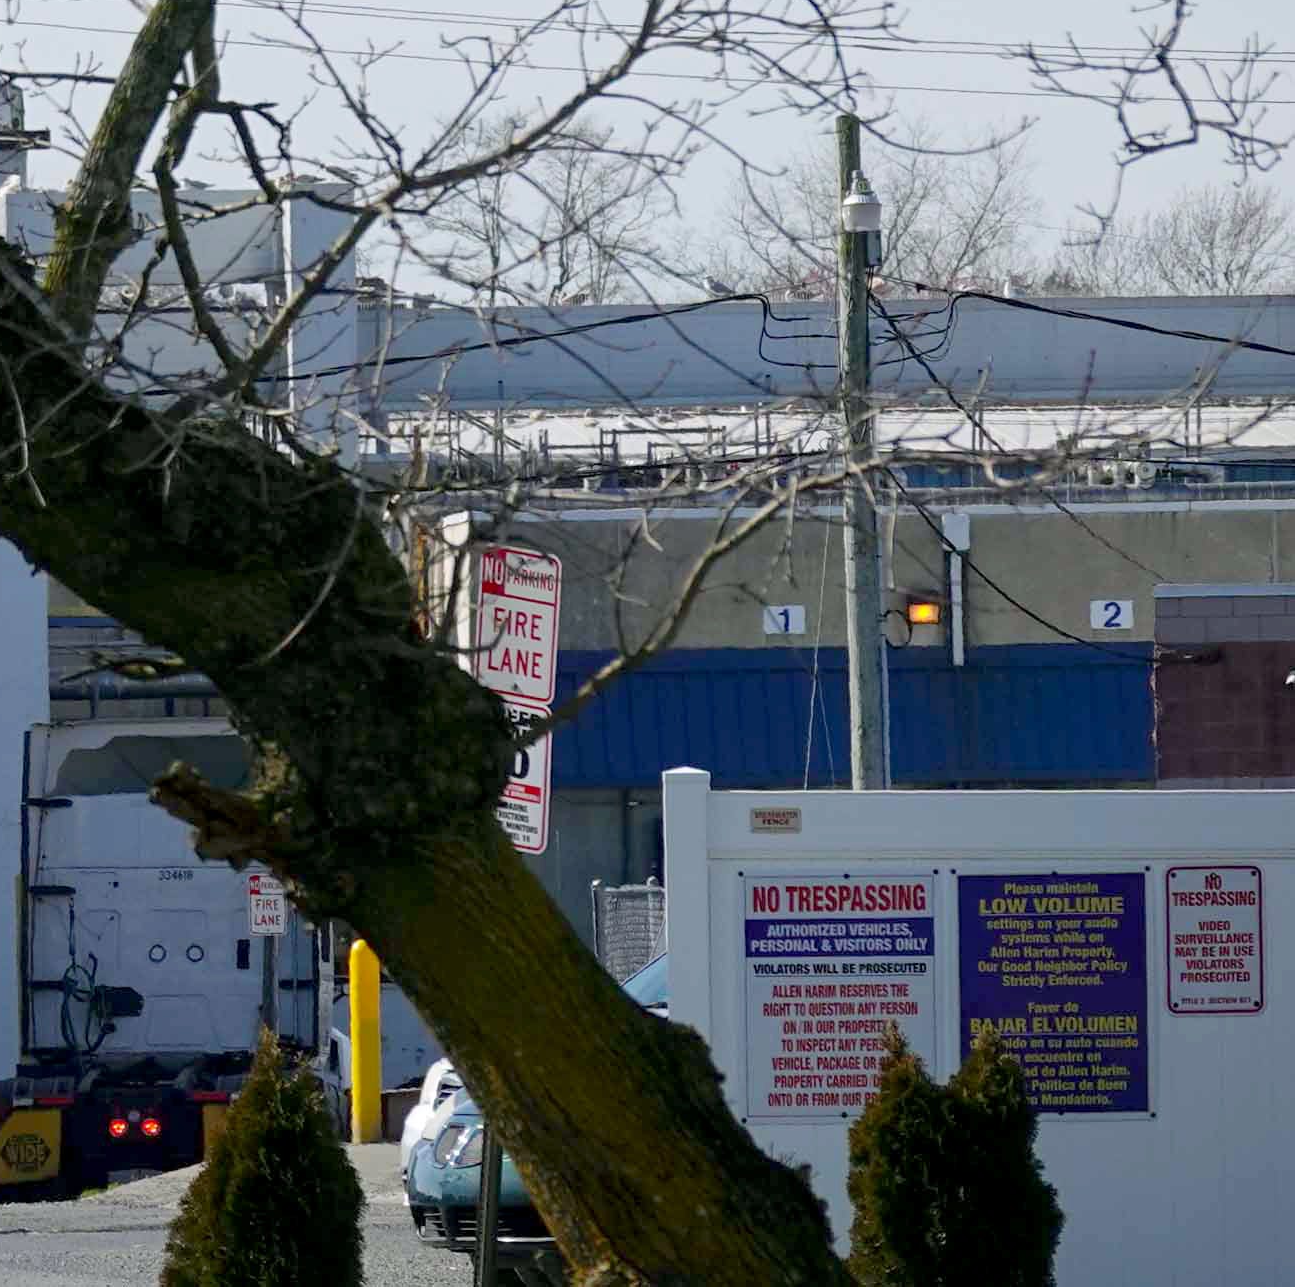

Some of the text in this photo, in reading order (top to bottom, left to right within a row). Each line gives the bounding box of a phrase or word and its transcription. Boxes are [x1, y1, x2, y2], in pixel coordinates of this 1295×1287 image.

[483, 555, 554, 591] NO PARKING
[778, 609, 789, 632] 1
[1104, 602, 1121, 627] 2
[494, 607, 542, 641] FIRE
[488, 648, 543, 679] LANE
[1004, 882, 1099, 894] Please maintain
[1205, 875, 1222, 890] NO
[255, 899, 279, 910] FIRE
[753, 884, 926, 912] NO TRESPASSING
[1172, 891, 1256, 906] TRESPASSING
[979, 897, 1125, 914] LOW VOLUME
[254, 915, 281, 926] LANE
[986, 917, 1118, 931] settings on your audio
[1198, 921, 1231, 931] VIDEO
[767, 923, 913, 938] AUTHORIZED VEHICLES,
[751, 937, 928, 952] PERSONAL & VISITORS ONLY
[1001, 932, 1104, 945] systems while on
[1175, 933, 1254, 945] SURVEILLANCE
[991, 947, 1021, 958] Allen
[1024, 947, 1059, 958] Harim
[1175, 946, 1254, 957] MAY BE IN USE
[753, 963, 927, 974] VIOLATORS WILL BE PROSECUTED
[978, 960, 1127, 974] Our Good Neighbor Policy
[1186, 959, 1244, 970] VIOLATORS
[1002, 975, 1045, 988] Strictly
[1181, 972, 1250, 983] PROSECUTED
[772, 984, 909, 998] ALLEN HARIM RESERVES THE
[763, 1002, 918, 1016] RIGHT TO QUESTION ANY PERSON
[1028, 1002, 1079, 1013] Favor de
[783, 1021, 797, 1034] ON
[816, 1021, 835, 1033] OUR
[970, 1016, 1138, 1033] BAJAR EL VOLUMEN
[782, 1039, 793, 1052] TO
[796, 1039, 837, 1052] INSPECT
[839, 1039, 857, 1051] ANY
[1066, 1038, 1093, 1048] auto
[1095, 1037, 1139, 1049] cuando
[772, 1057, 814, 1071] VEHICLE,
[817, 1057, 860, 1070] PACKAGE
[863, 1057, 876, 1070] OR
[1042, 1066, 1056, 1077] de
[1059, 1066, 1088, 1077] Allen
[774, 1075, 823, 1088] PROPERTY
[827, 1075, 868, 1088] CARRIED
[768, 1094, 792, 1106] ONTO
[796, 1094, 809, 1106] OR
[812, 1093, 840, 1106] FROM
[842, 1093, 861, 1106] OUR
